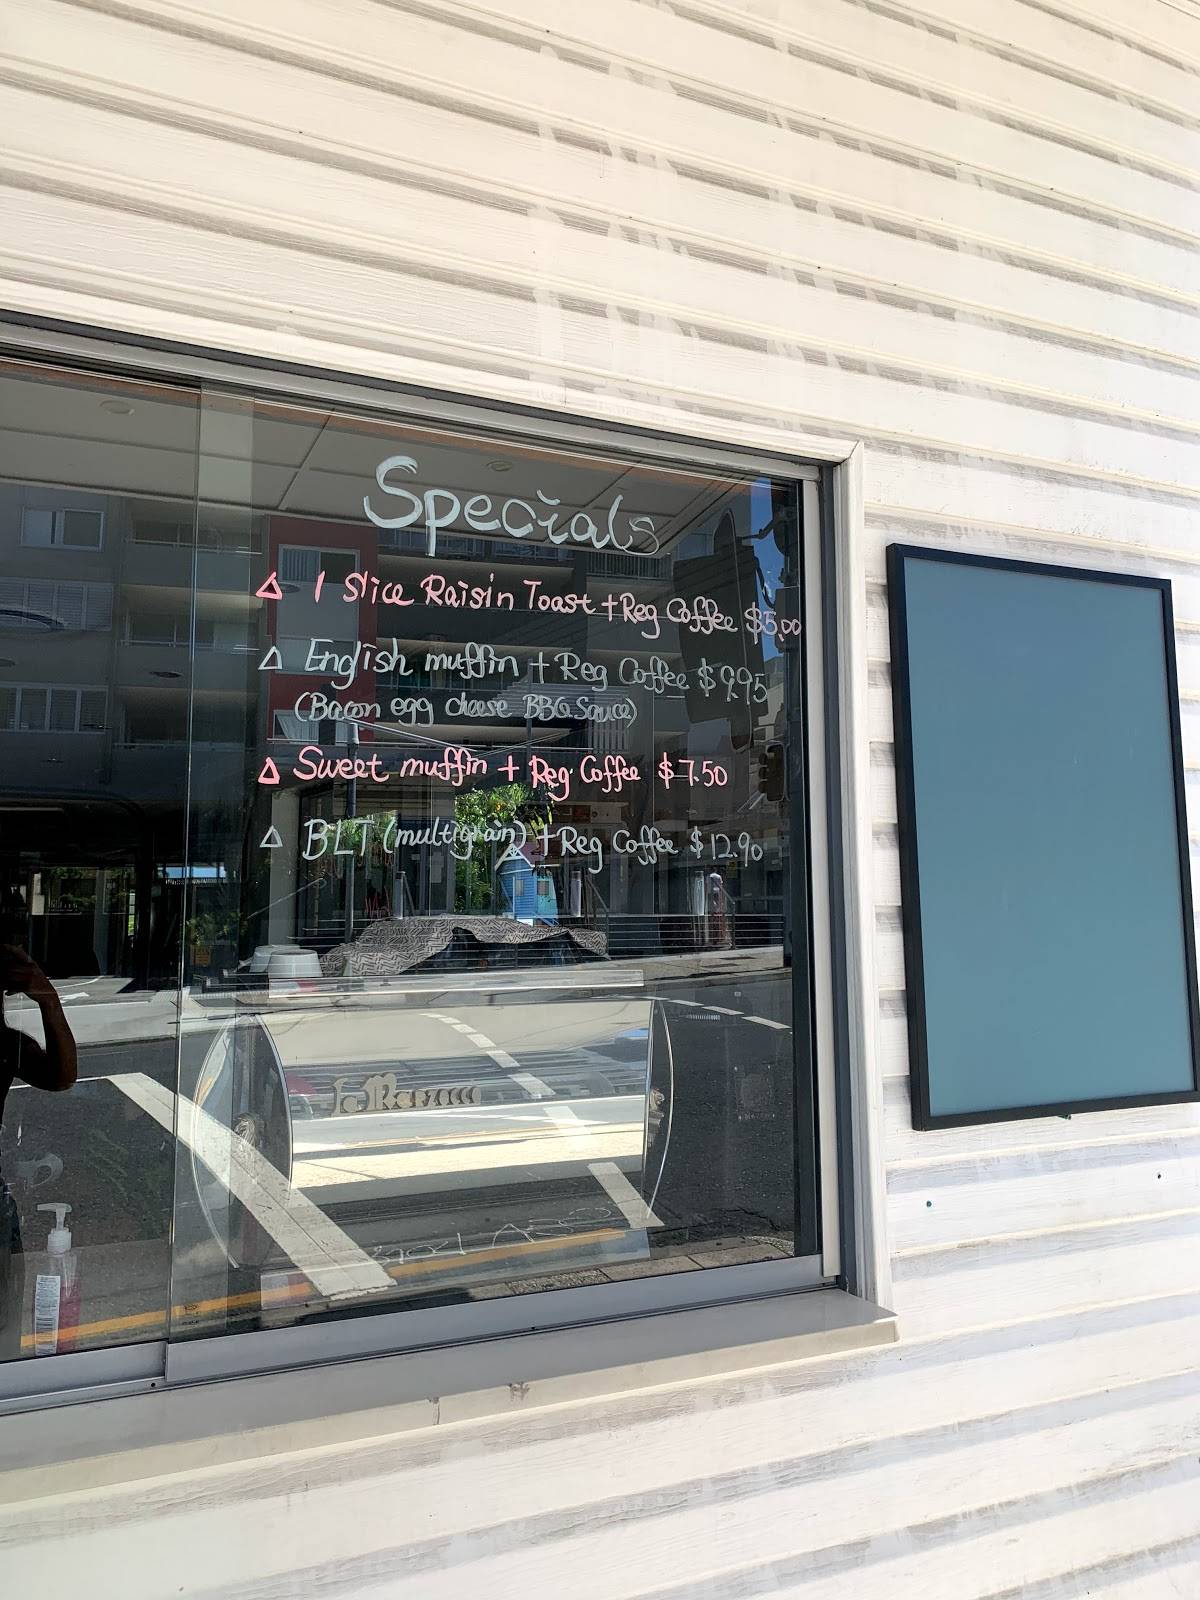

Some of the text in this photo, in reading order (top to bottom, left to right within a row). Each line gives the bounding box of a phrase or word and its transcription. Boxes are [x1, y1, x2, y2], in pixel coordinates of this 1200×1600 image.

[363, 455, 660, 557] Specials
[343, 570, 415, 606] Slice
[420, 572, 515, 611] Raisin
[523, 579, 597, 616] Toast
[666, 596, 739, 635] Coffee
[744, 601, 802, 645] $5.00
[304, 637, 414, 690] English
[425, 641, 519, 680] muffin
[554, 652, 608, 692] Reg
[618, 655, 691, 695] Coffee
[294, 691, 381, 722] (Bacon
[390, 697, 434, 728] egg
[574, 695, 639, 729] Sauce)
[293, 745, 390, 783] Sweet
[400, 746, 488, 787] muffin
[580, 755, 642, 793] Coffee
[302, 818, 375, 861] BLT
[612, 825, 680, 867] Coffee
